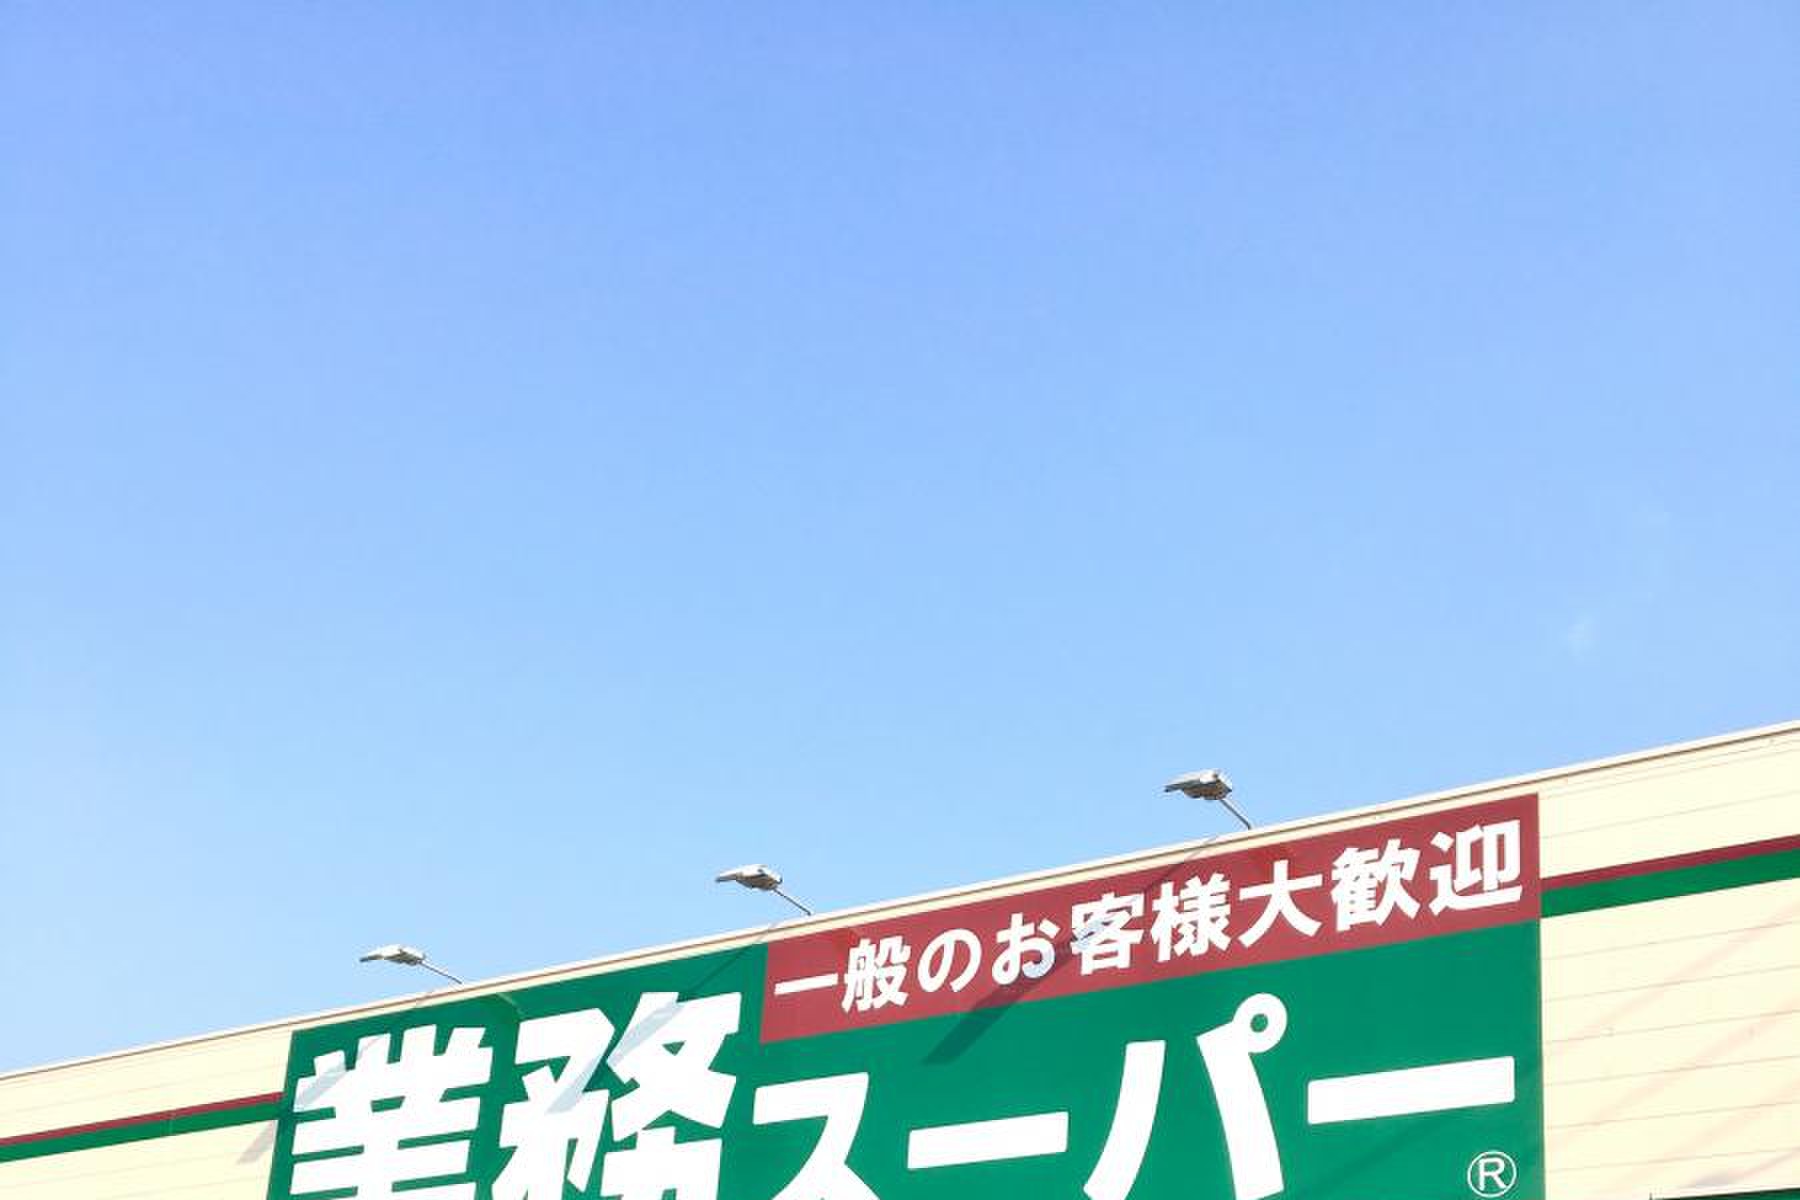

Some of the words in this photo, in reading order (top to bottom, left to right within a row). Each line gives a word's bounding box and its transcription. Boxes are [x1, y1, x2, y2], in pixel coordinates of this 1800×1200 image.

[773, 818, 1523, 1013] 一般のお客様大歓迎
